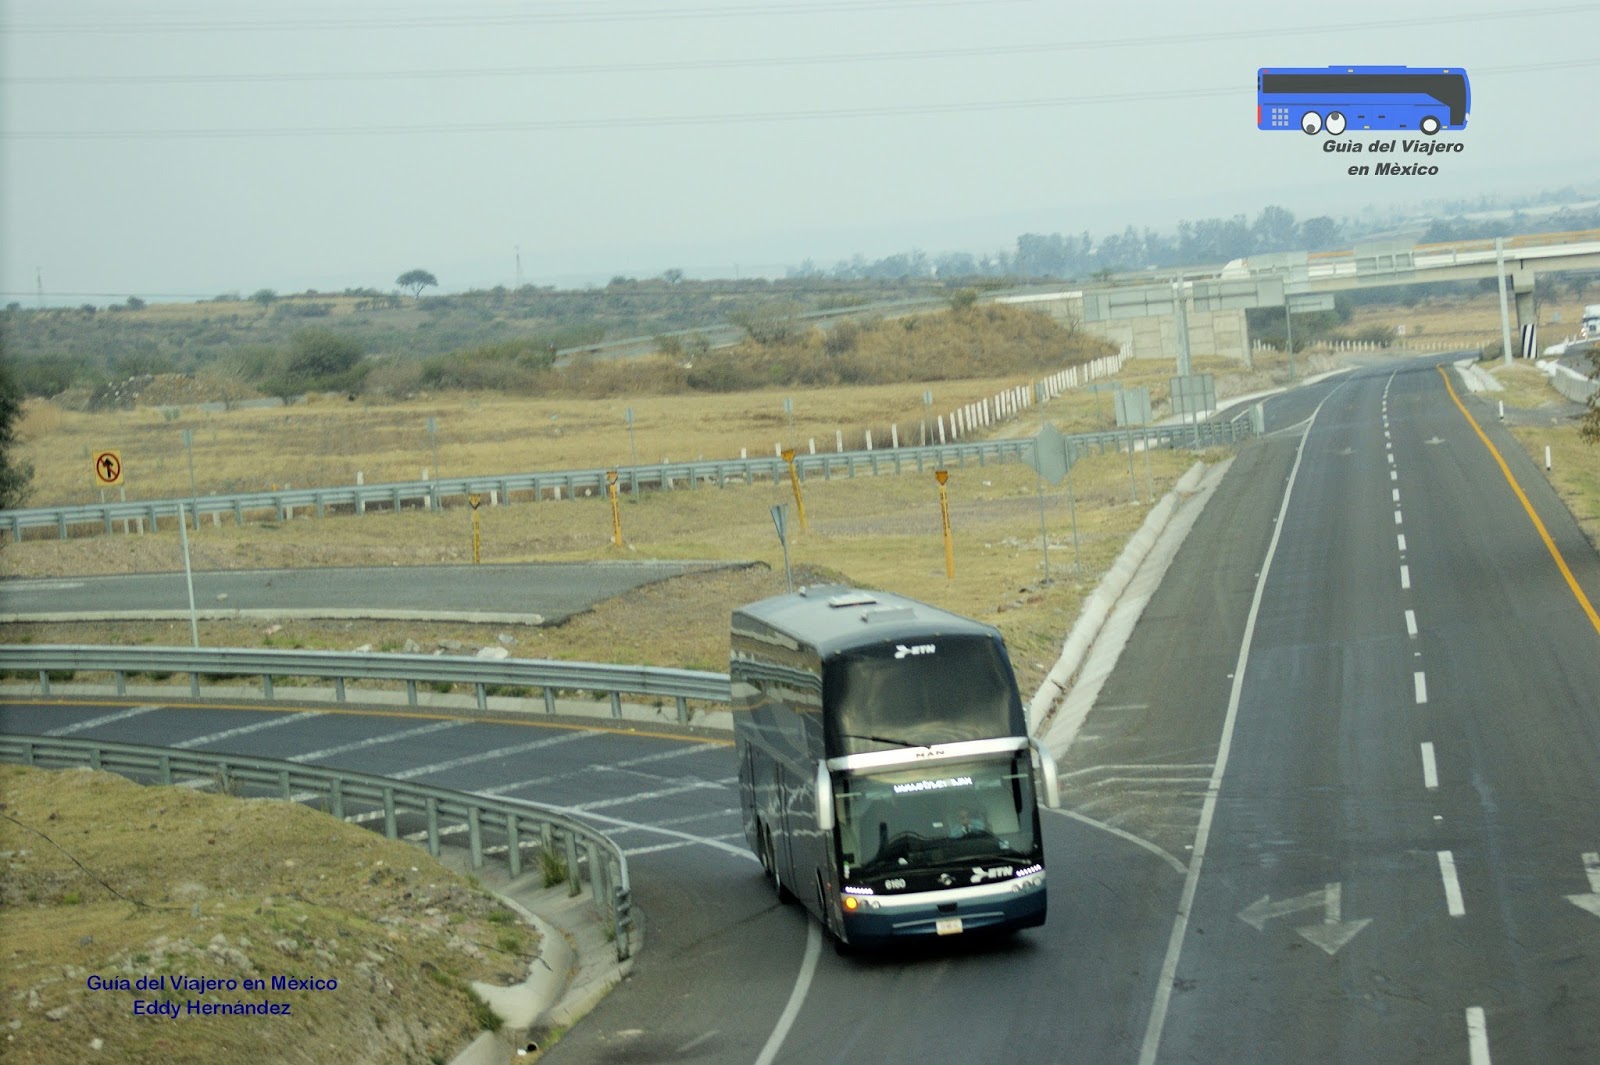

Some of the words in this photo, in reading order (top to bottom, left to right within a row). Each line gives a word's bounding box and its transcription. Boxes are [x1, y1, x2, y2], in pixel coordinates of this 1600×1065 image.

[911, 643, 936, 656] ETN
[915, 750, 945, 758] MAN
[987, 865, 1014, 879] ETN
